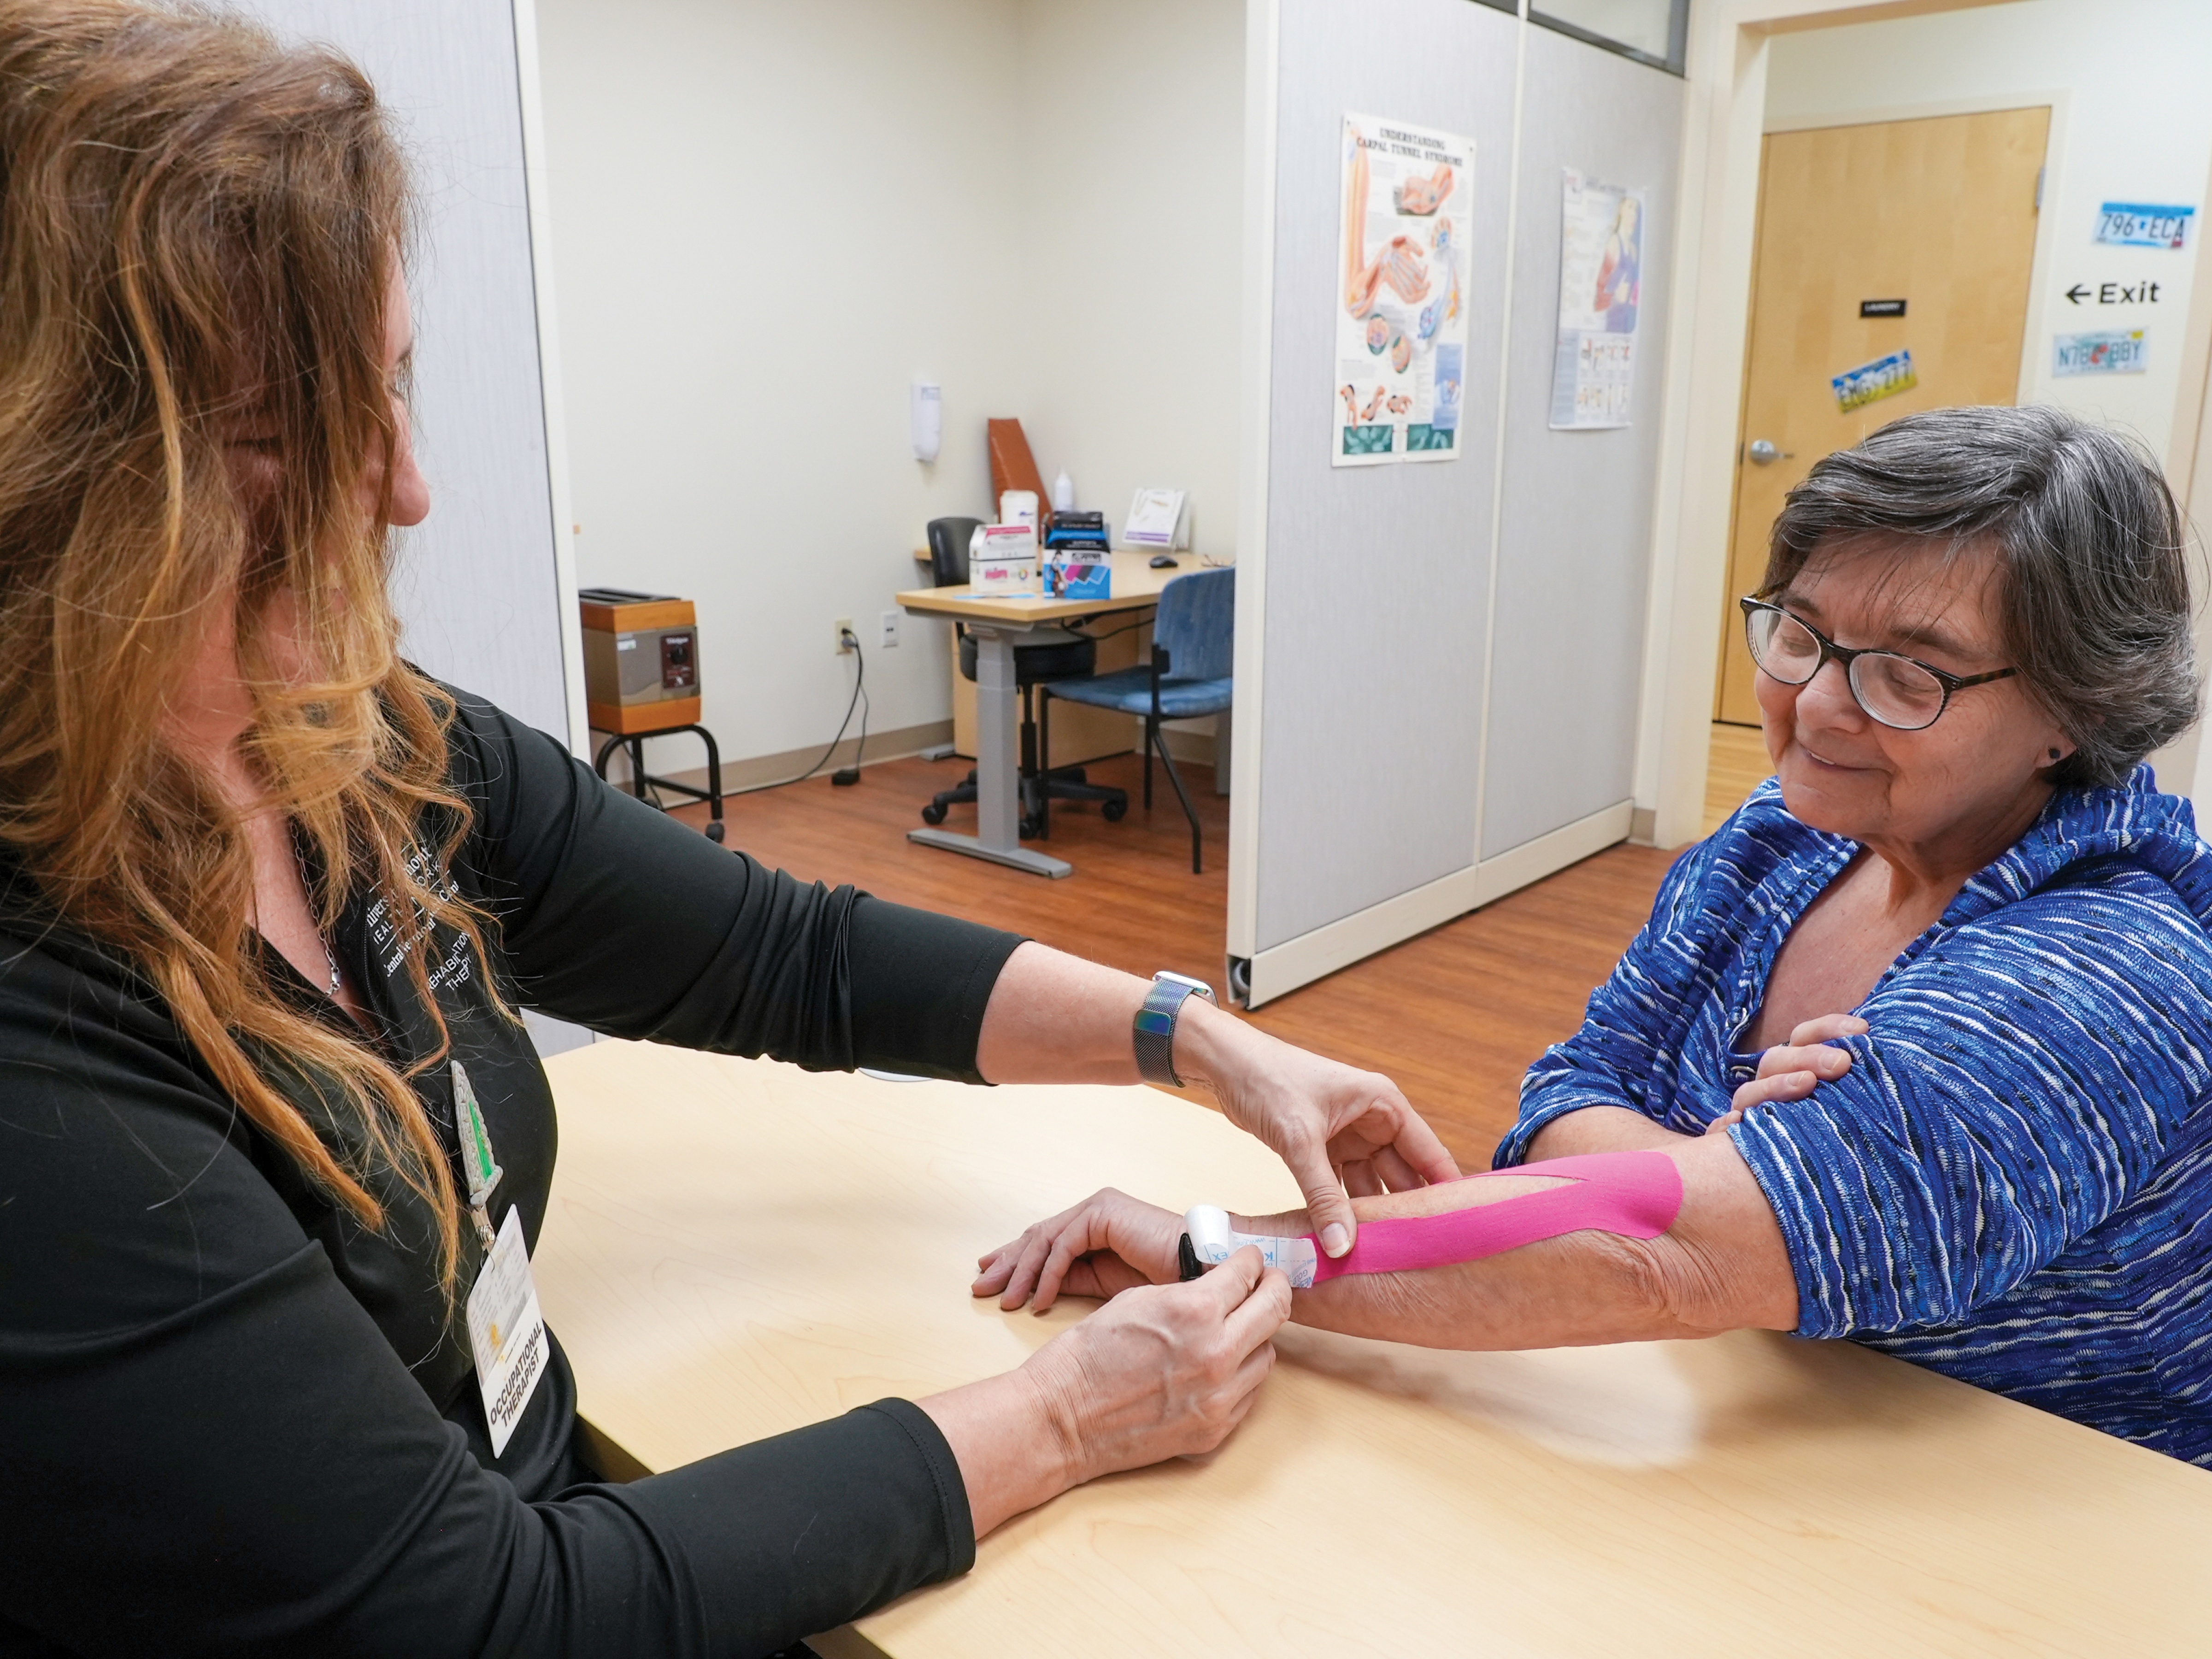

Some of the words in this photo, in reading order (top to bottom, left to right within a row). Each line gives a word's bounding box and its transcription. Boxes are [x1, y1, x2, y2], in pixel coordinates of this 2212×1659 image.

[1357, 136, 1387, 152] CARPAL
[1392, 143, 1421, 158] TUNNEL
[1424, 151, 1463, 166] SYNDROME
[1379, 127, 1445, 151] UNDERSTANDING
[2100, 281, 2159, 303] Exit
[490, 1321, 542, 1425] OCCUPATIONAL
[501, 1347, 539, 1428] THERAPIST
